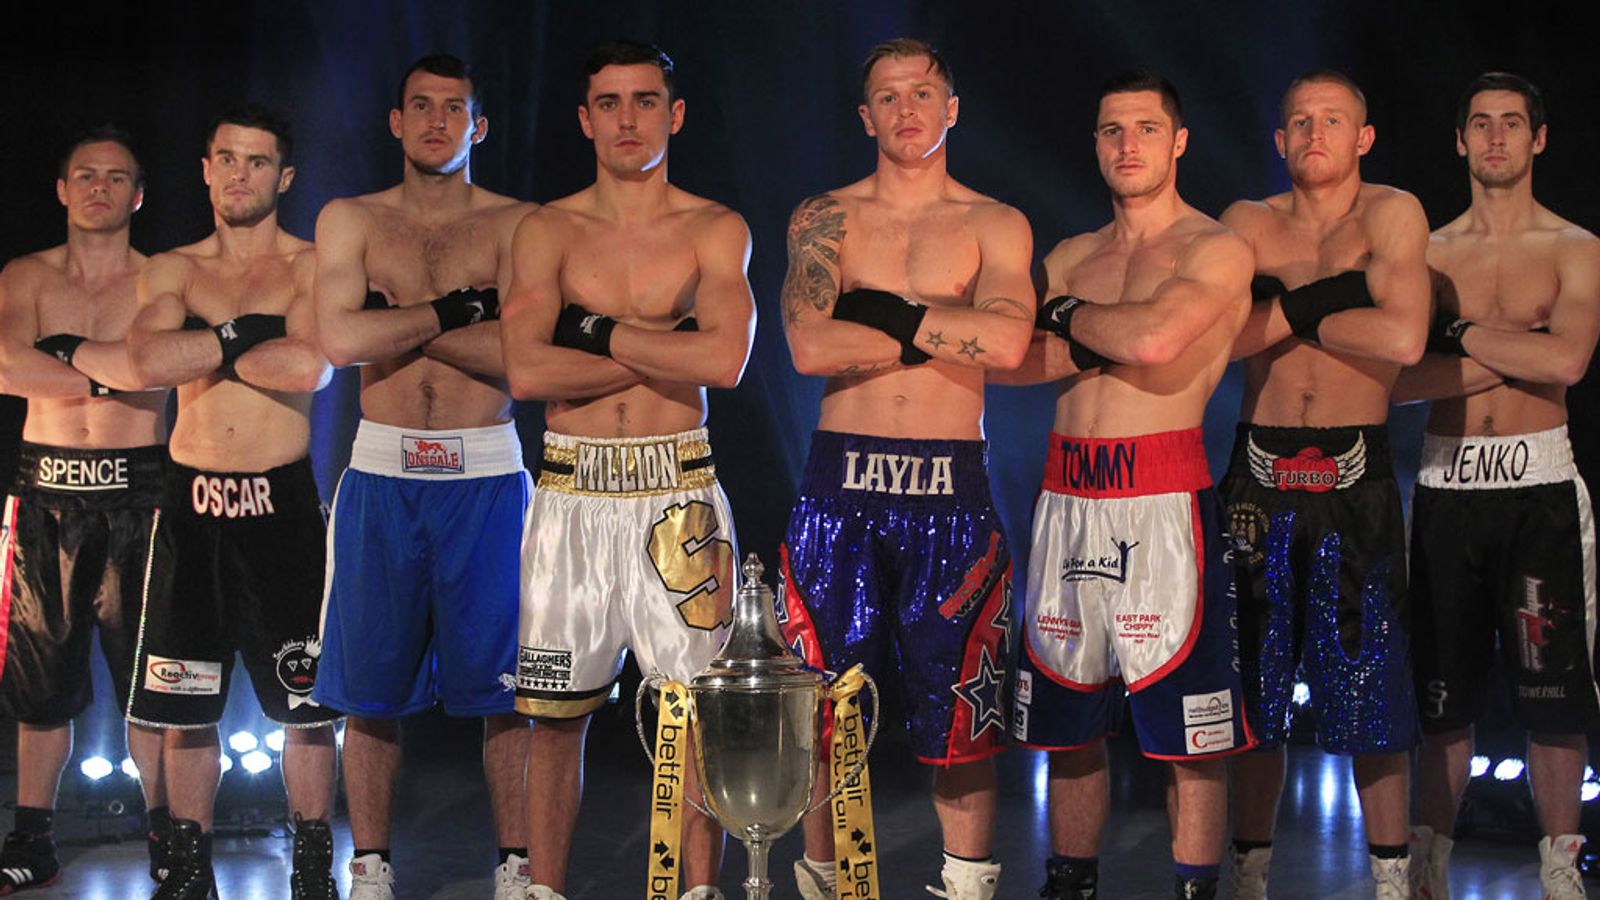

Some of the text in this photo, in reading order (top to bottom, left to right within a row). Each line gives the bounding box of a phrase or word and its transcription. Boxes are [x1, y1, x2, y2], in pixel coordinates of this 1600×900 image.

[38, 457, 128, 485] SPENCE
[576, 442, 679, 491] MILLION
[842, 451, 954, 495] LAYLA
[1061, 441, 1136, 491] TOMMY
[1275, 470, 1335, 486] TURBO
[1444, 440, 1529, 484] JENKO
[191, 475, 275, 518] OSCAR
[1087, 559, 1095, 568] a
[1099, 556, 1118, 568] Kid
[1116, 614, 1161, 623] EAST PARK
[1124, 623, 1154, 632] CHIPPY
[655, 724, 683, 821] betfair
